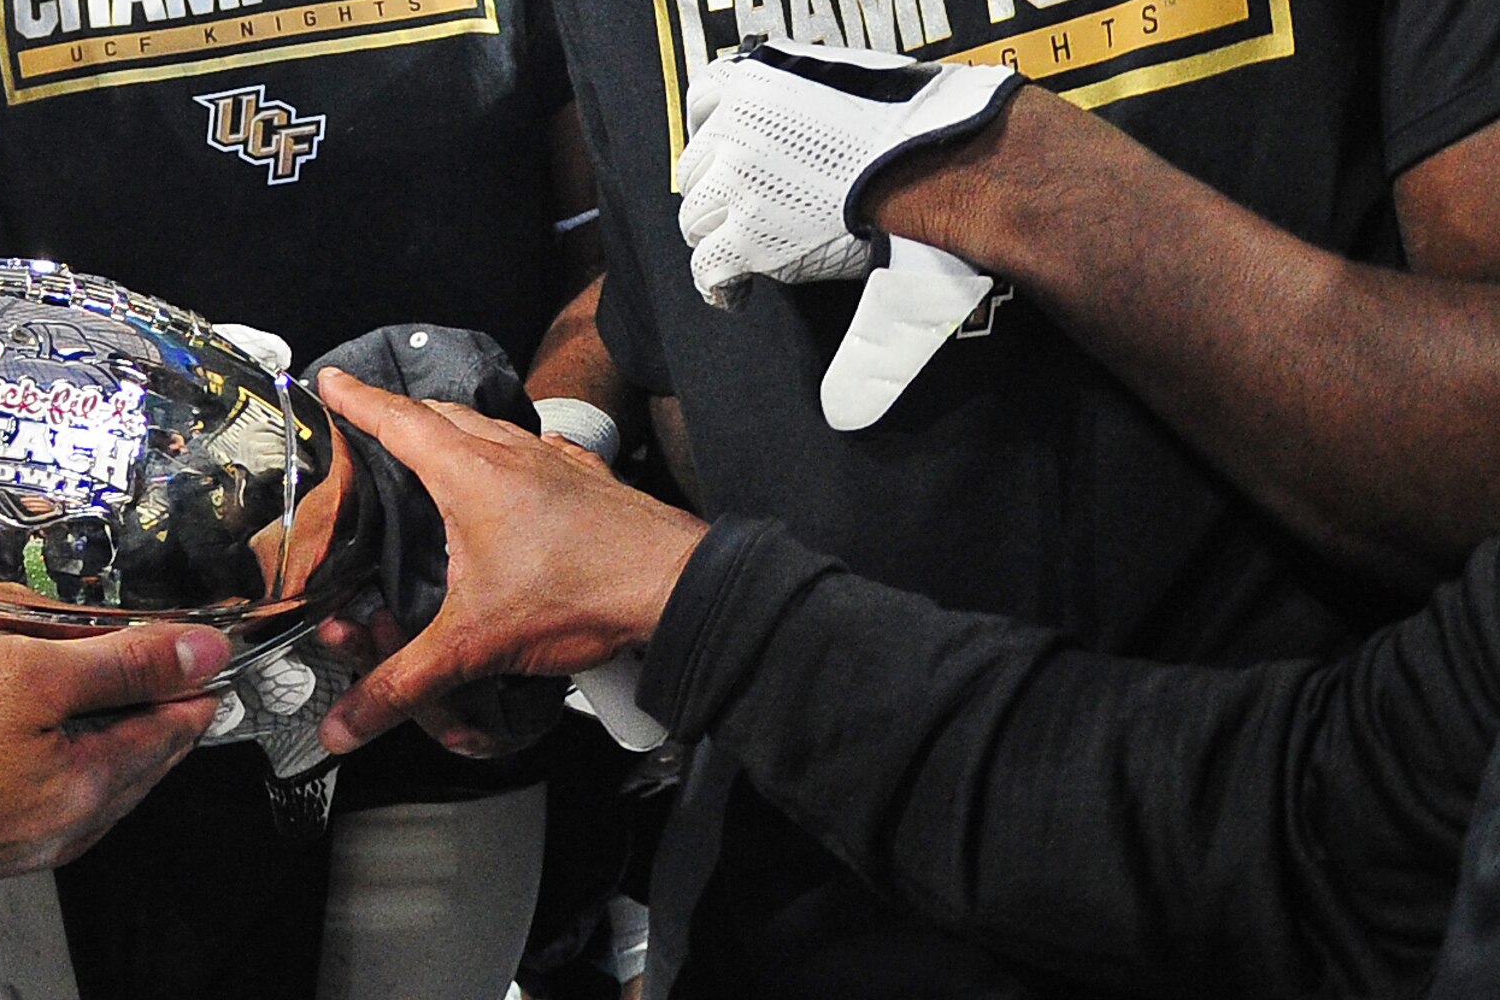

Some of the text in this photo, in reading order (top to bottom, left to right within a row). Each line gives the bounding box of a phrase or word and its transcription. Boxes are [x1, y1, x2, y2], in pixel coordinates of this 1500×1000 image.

[70, 36, 153, 63] UCF
[968, 3, 1160, 70] GHTS
[192, 83, 327, 186] UCF
